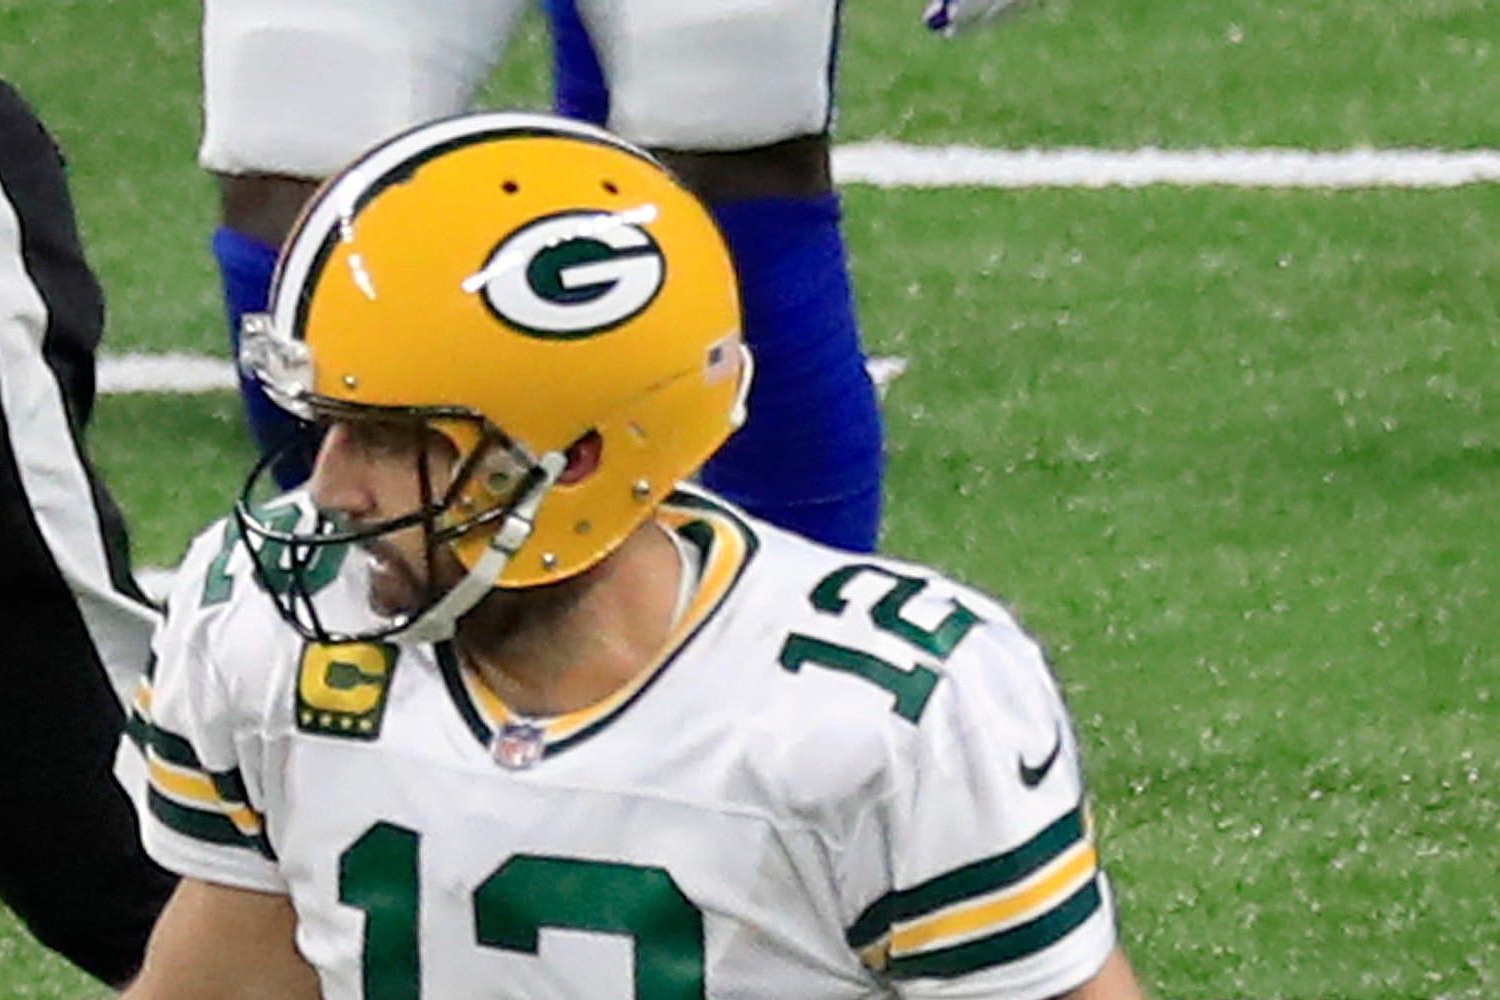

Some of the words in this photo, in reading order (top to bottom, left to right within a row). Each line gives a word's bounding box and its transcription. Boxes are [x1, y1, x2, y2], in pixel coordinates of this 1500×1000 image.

[478, 208, 667, 341] G
[301, 641, 388, 715] C
[777, 563, 985, 727] 12
